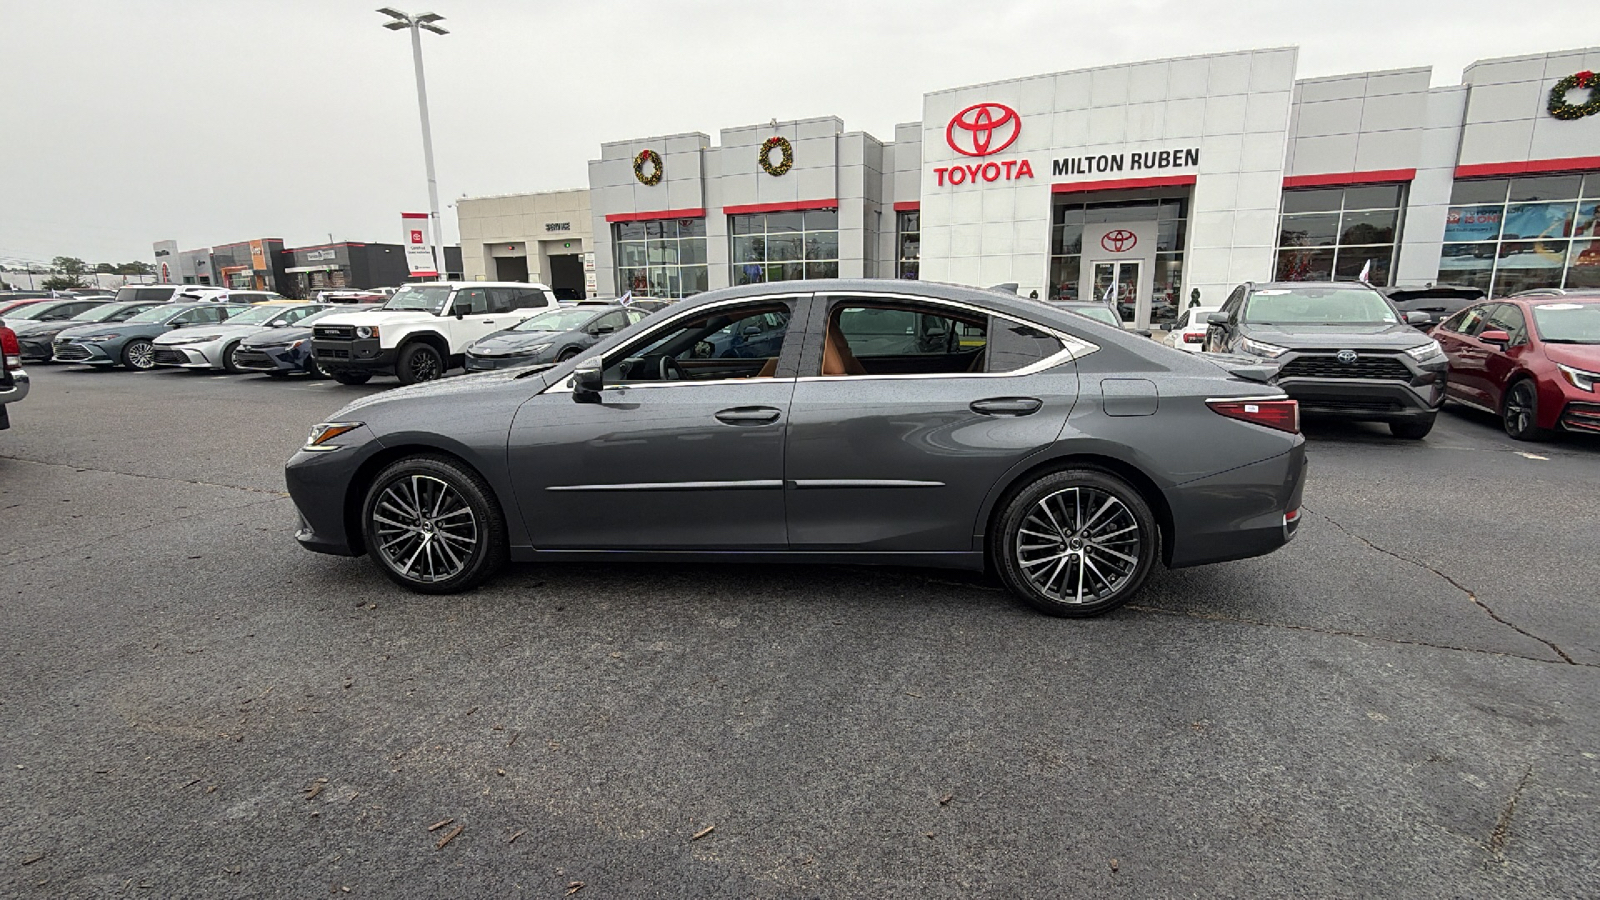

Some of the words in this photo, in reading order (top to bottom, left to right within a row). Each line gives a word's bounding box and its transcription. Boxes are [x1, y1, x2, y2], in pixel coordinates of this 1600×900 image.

[933, 159, 1034, 187] TOYOTA
[1052, 153, 1124, 176] MILTON
[1130, 148, 1200, 170] RUBEN
